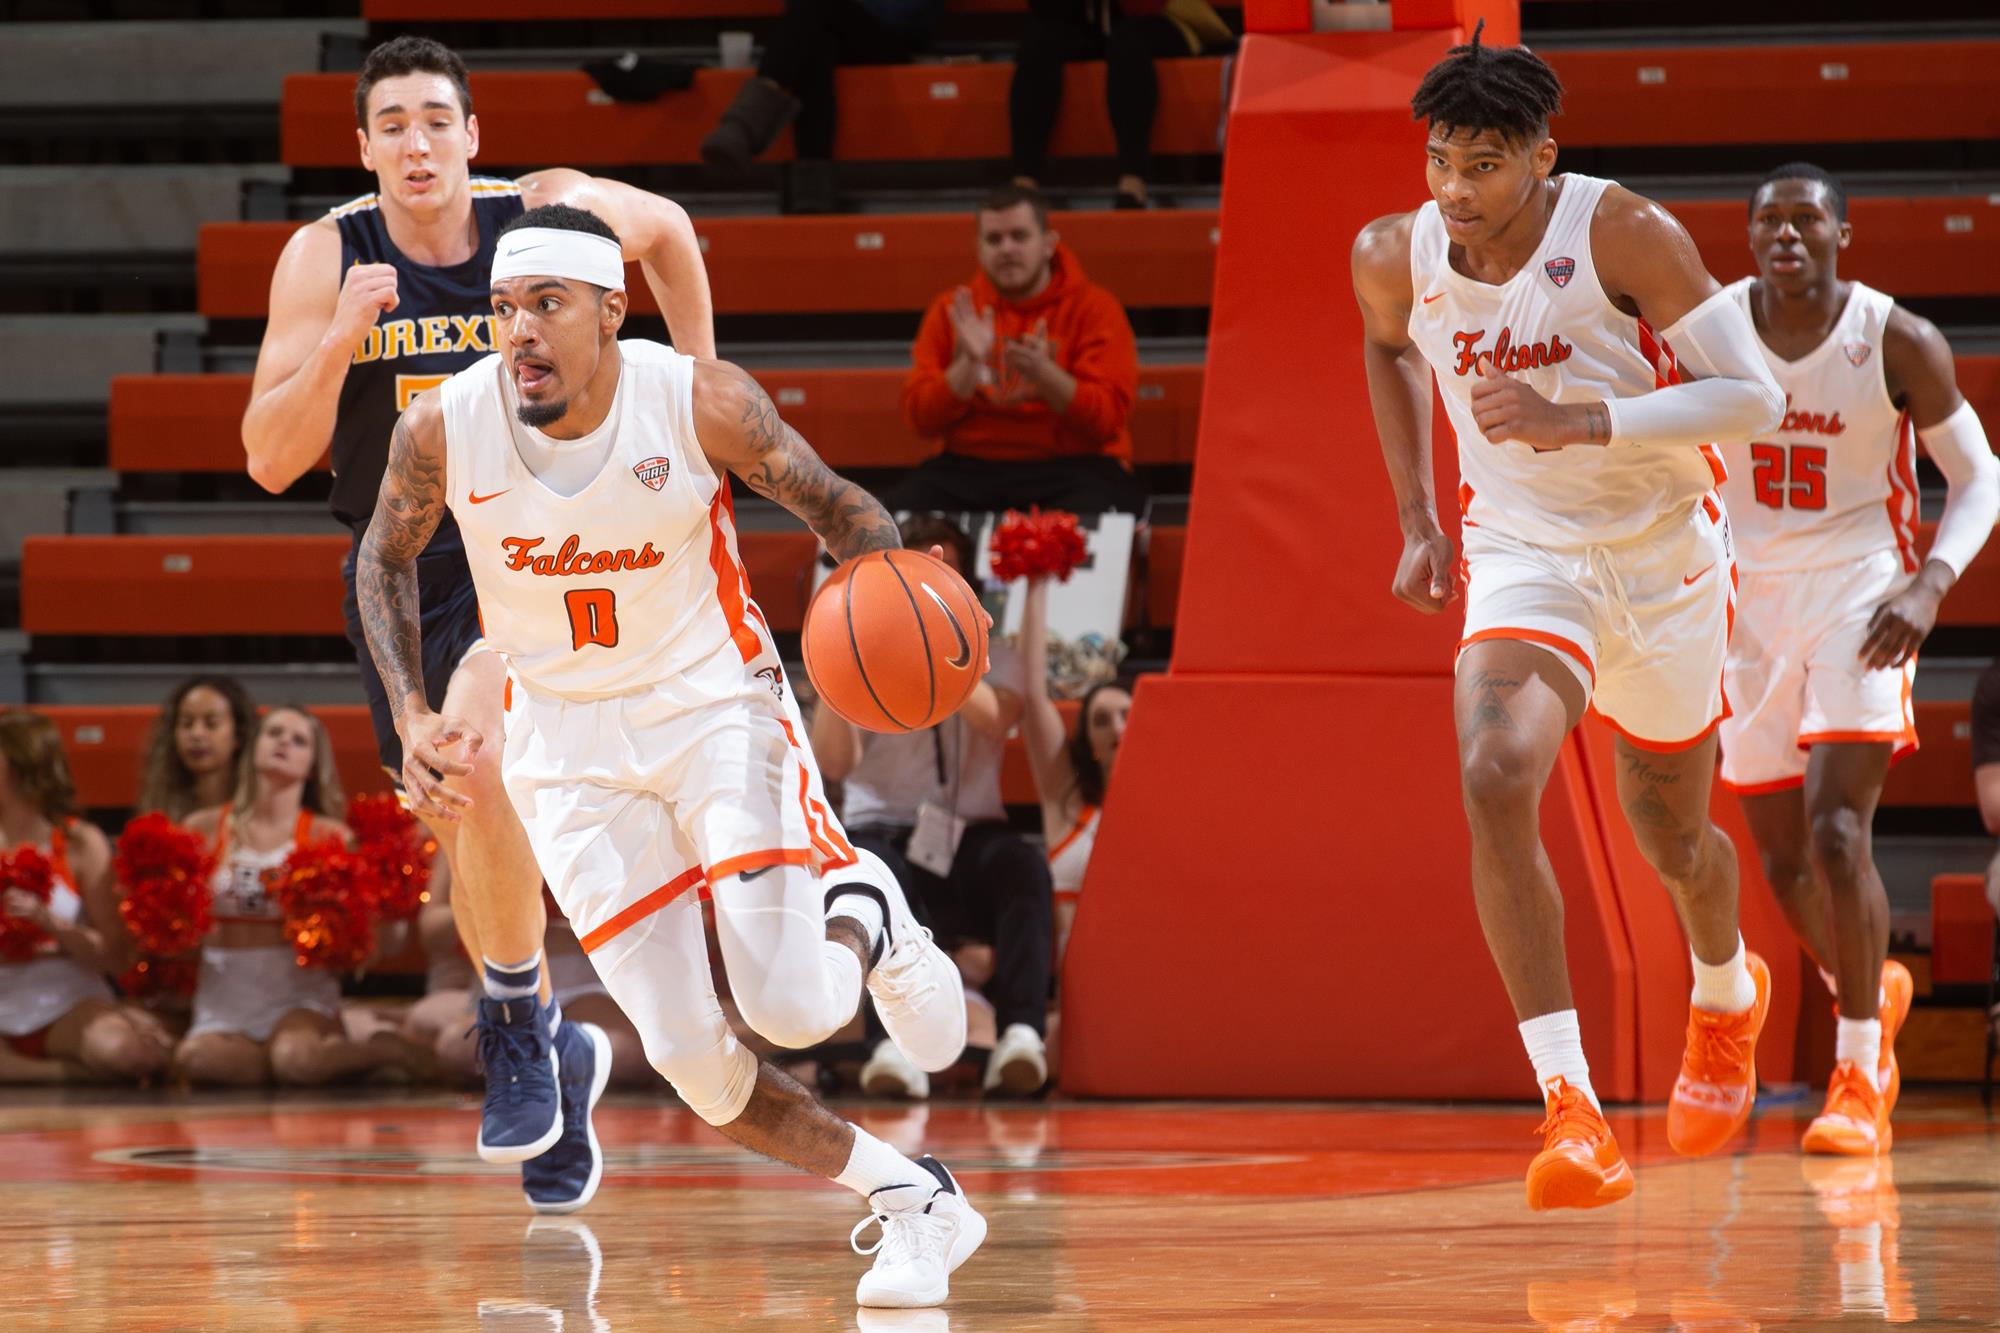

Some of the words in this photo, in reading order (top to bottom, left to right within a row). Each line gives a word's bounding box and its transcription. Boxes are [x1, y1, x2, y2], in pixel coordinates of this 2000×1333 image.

[1453, 327, 1572, 376] Falcons
[638, 463, 669, 481] MAC
[1750, 442, 1827, 512] 25
[501, 534, 665, 576] Falcons
[563, 588, 619, 652] 0
